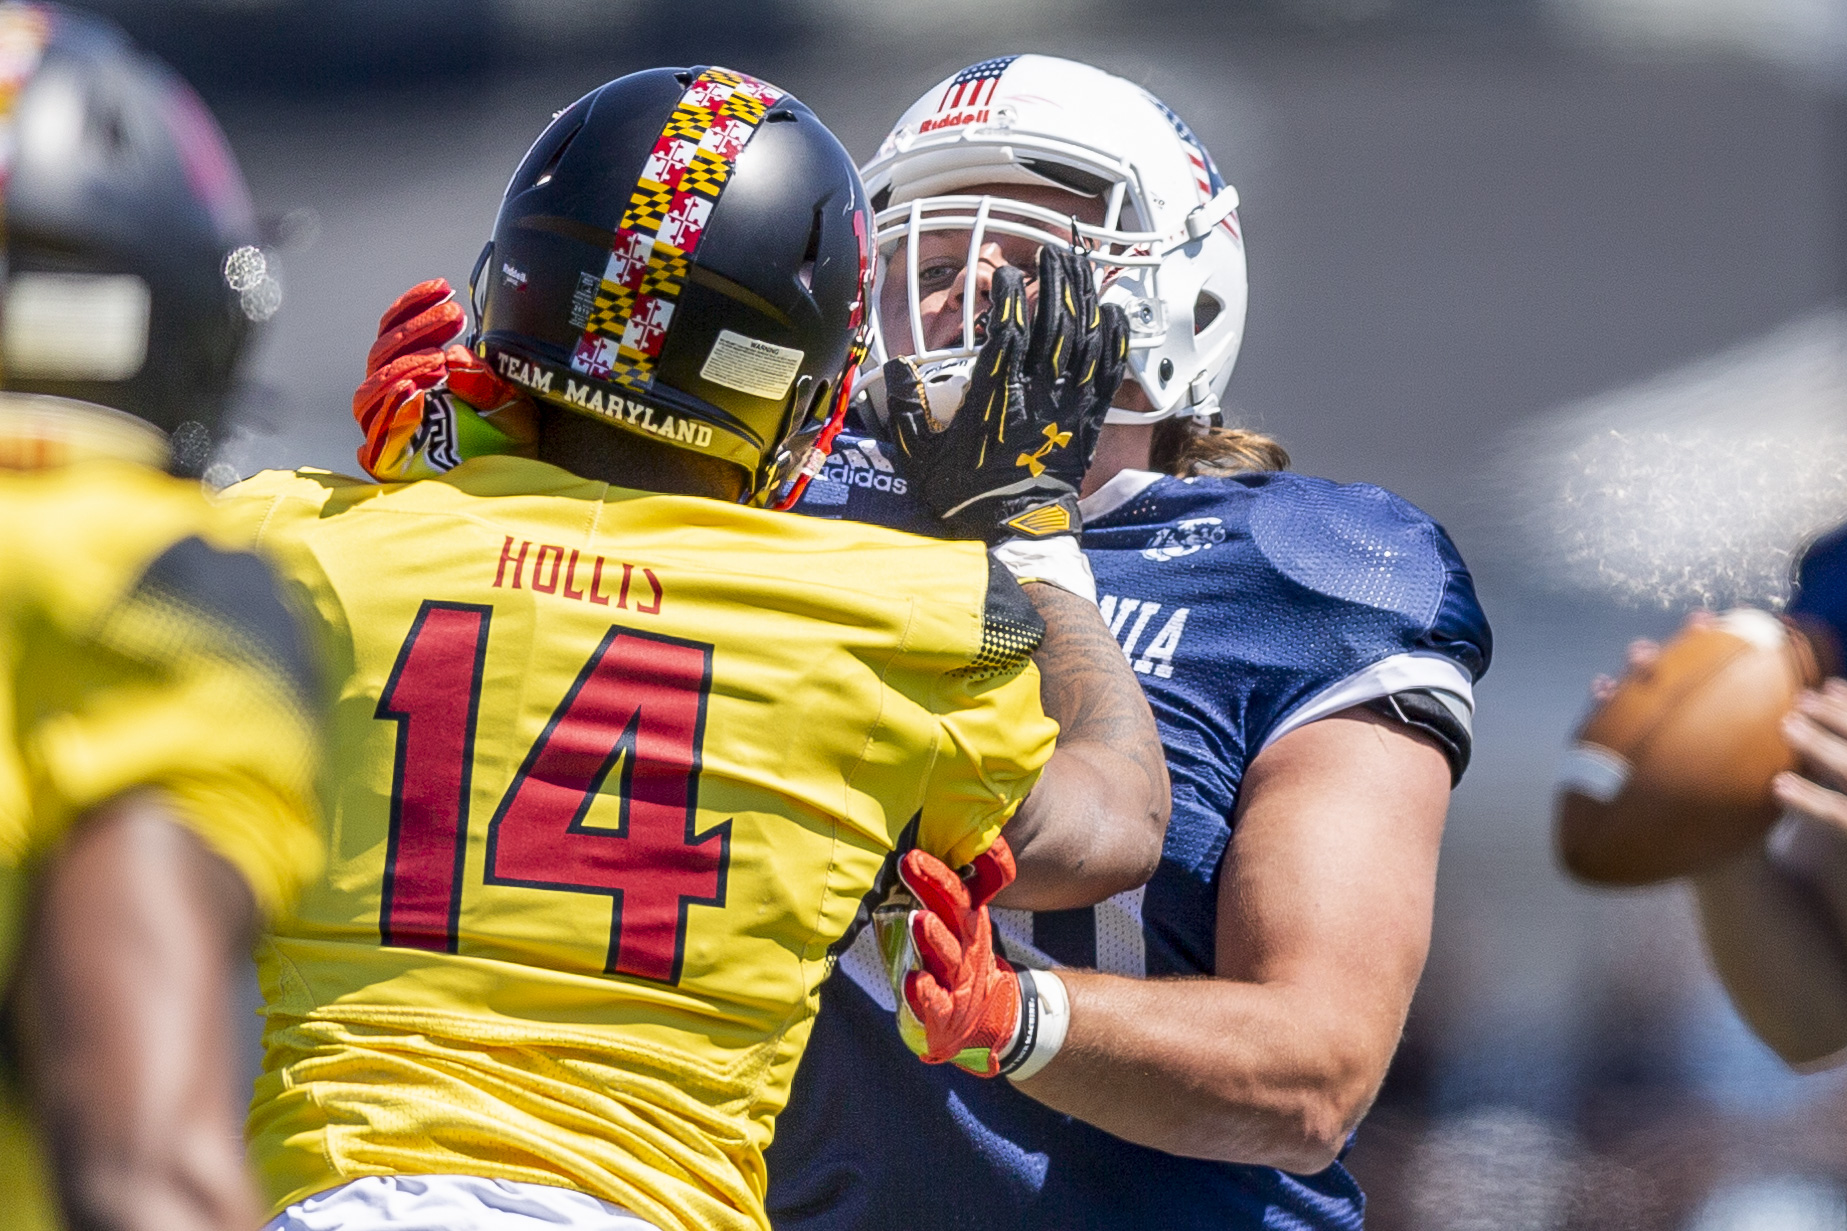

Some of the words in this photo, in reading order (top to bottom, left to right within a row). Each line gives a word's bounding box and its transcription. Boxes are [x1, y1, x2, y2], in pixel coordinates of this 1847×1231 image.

[918, 109, 990, 134] Riddell
[750, 341, 780, 355] WARNING
[497, 351, 554, 394] TEAM
[563, 379, 713, 448] MARYLAND
[492, 535, 664, 615] HOLLIS
[372, 598, 733, 988] 14
